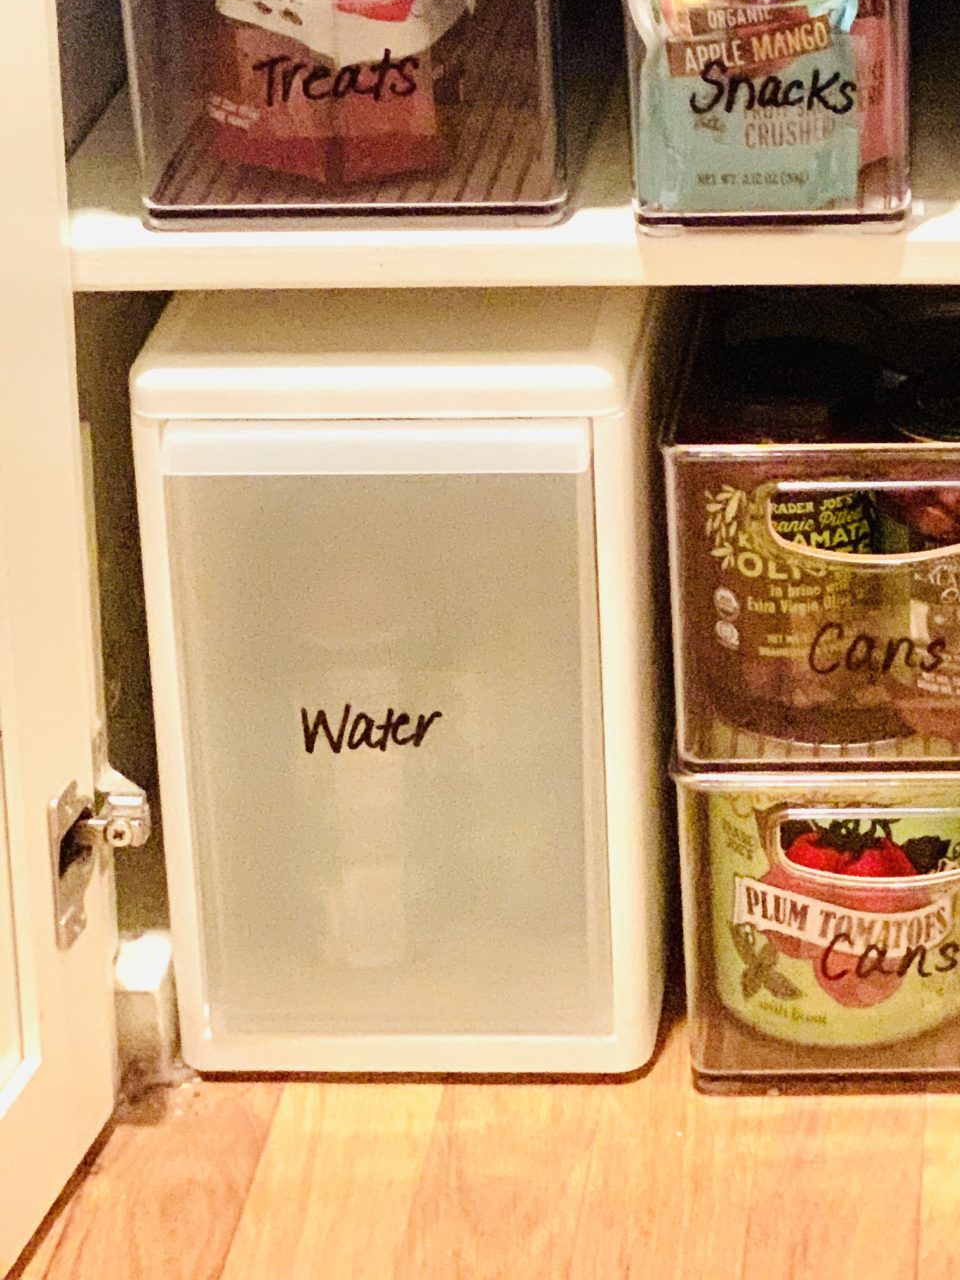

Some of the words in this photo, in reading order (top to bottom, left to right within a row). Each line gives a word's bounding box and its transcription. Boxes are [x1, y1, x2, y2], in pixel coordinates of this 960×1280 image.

[685, 40, 745, 73] APPLE
[751, 21, 829, 62] MANGO
[253, 48, 419, 106] Treats
[689, 59, 857, 114] Snacks
[768, 501, 815, 516] RADER
[808, 621, 947, 676] Cans
[301, 703, 443, 754] Water
[745, 886, 809, 933] PLUM
[819, 905, 947, 952] TOMATOES
[820, 933, 960, 980] Cans
